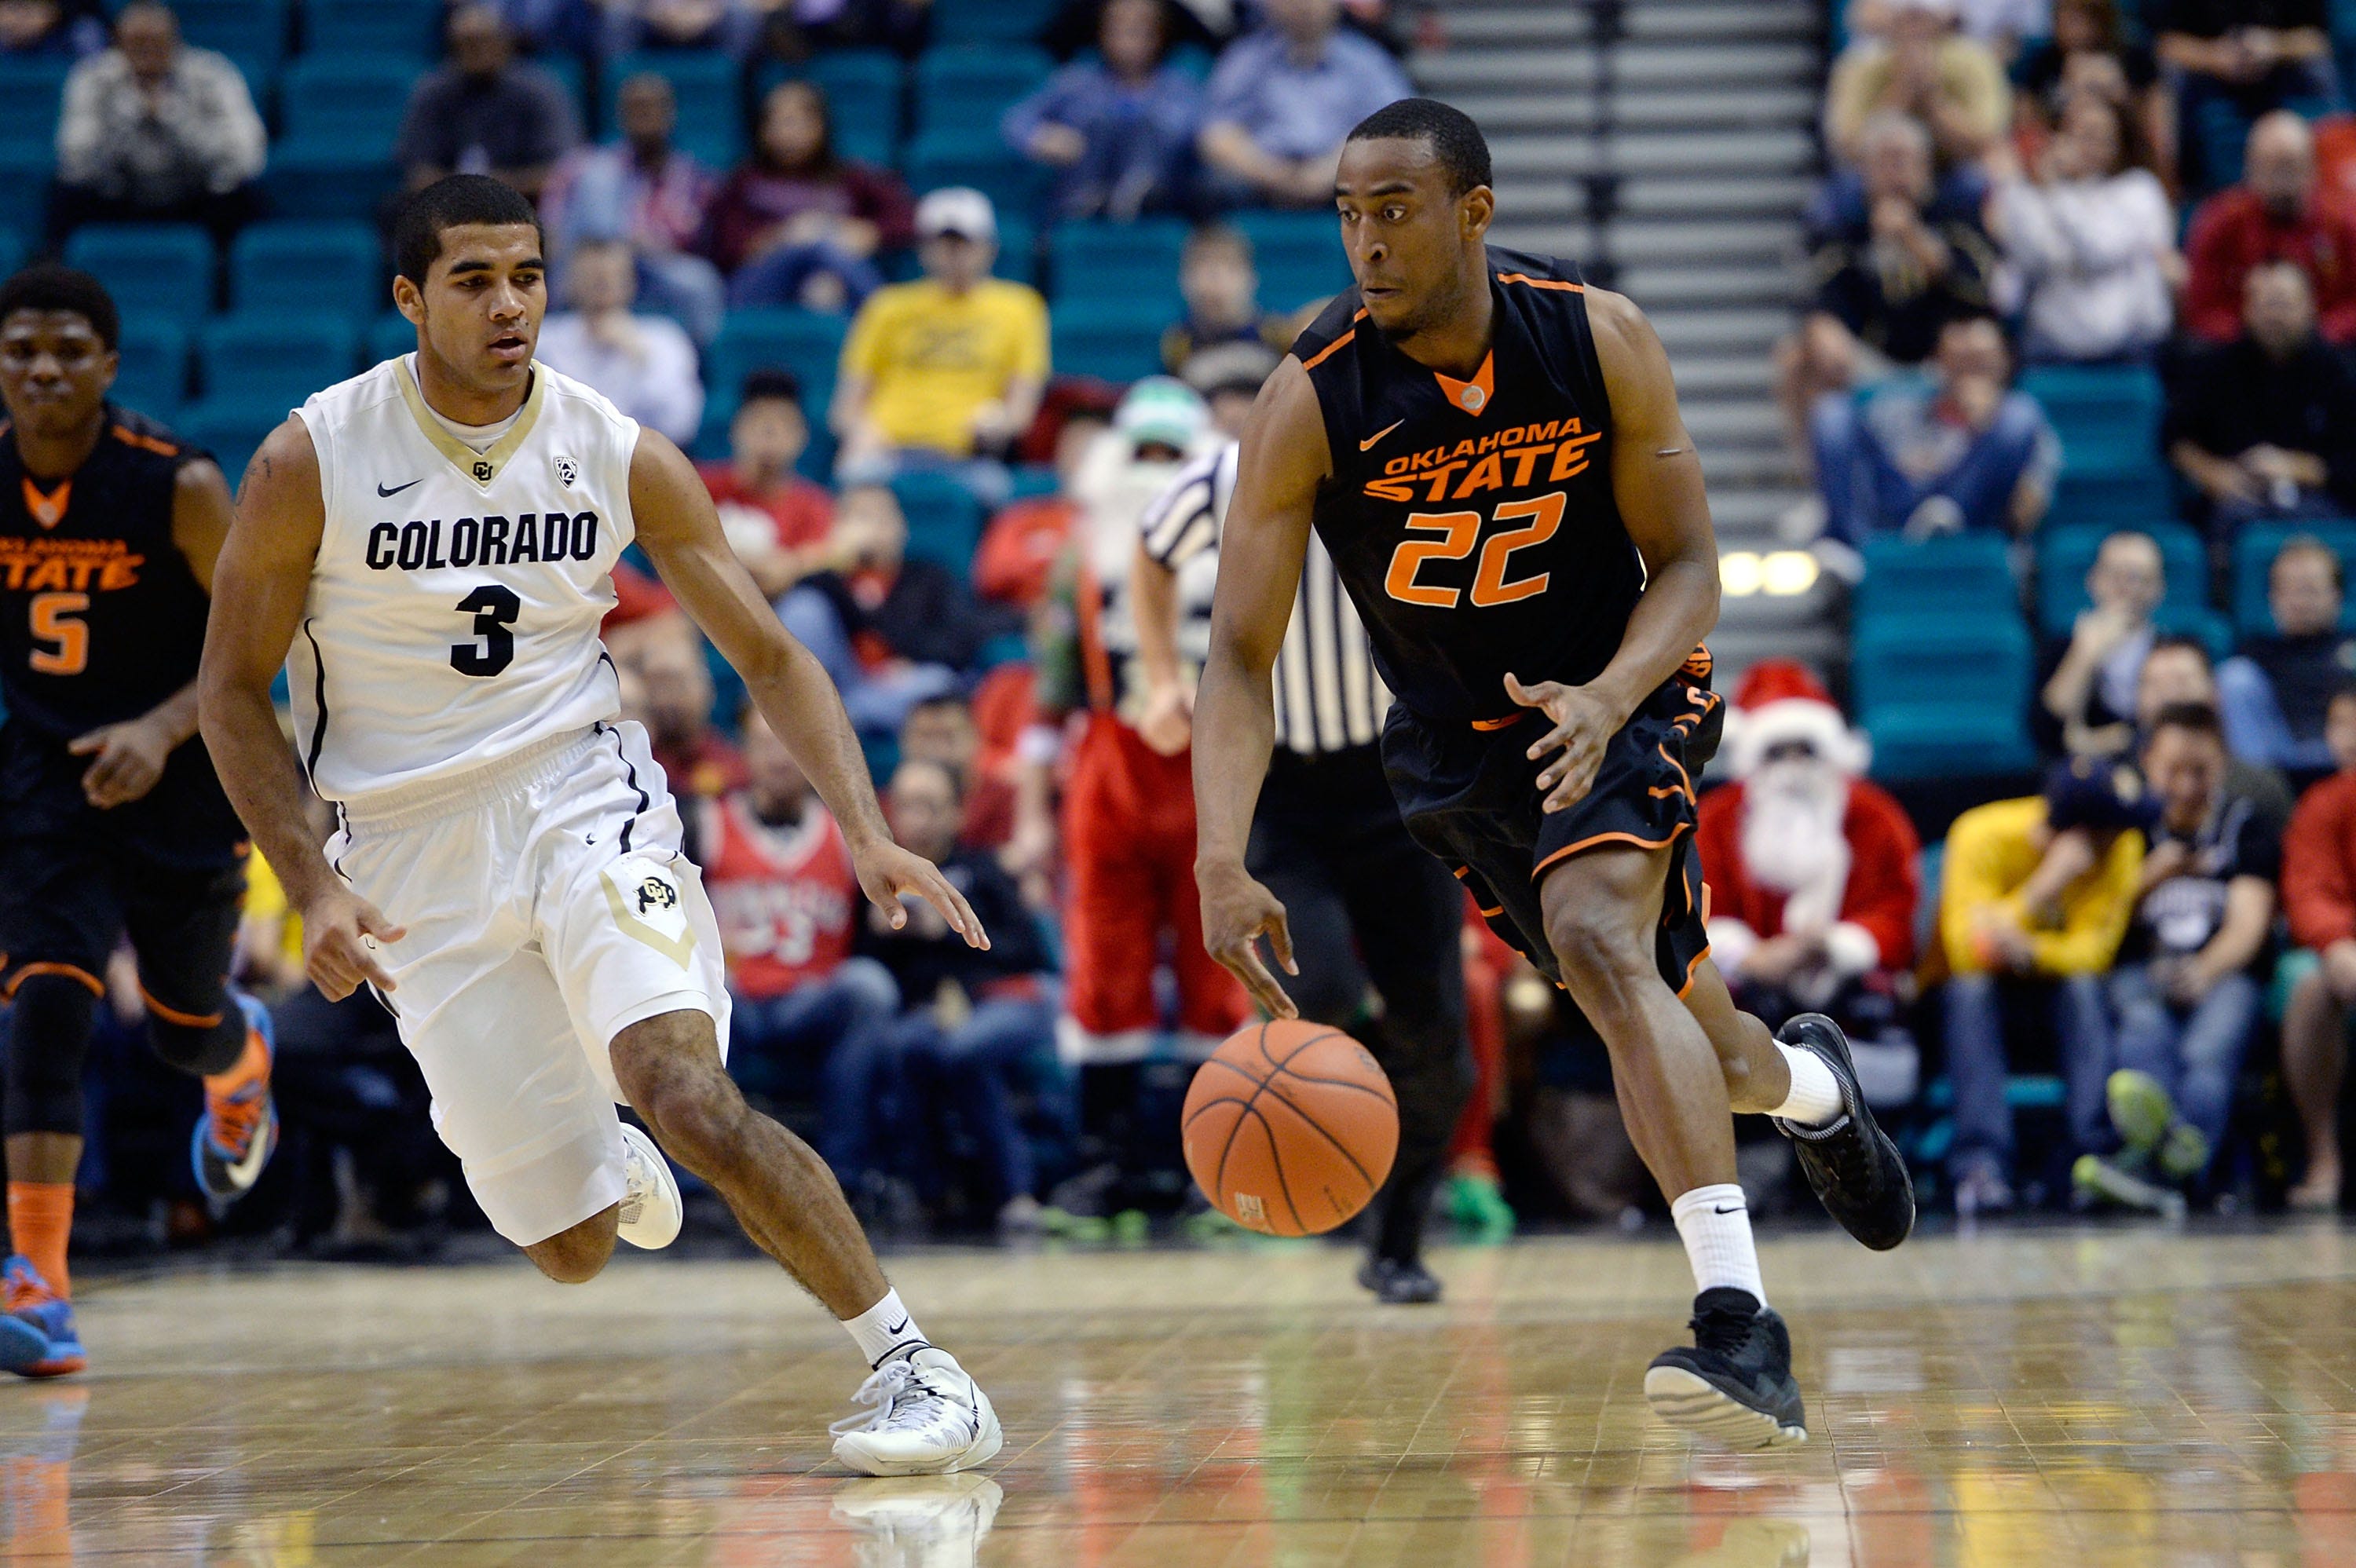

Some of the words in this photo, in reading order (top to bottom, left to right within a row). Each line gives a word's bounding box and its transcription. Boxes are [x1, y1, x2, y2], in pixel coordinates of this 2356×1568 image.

[473, 462, 493, 481] CU
[561, 469, 573, 481] 12
[1363, 432, 1602, 502] STATE
[1385, 418, 1582, 475] OKLAHOMA
[366, 511, 598, 570] COLORADO
[1385, 492, 1567, 609] 22
[0, 551, 145, 590] TATE
[29, 592, 90, 676] 5
[450, 585, 521, 677] 3
